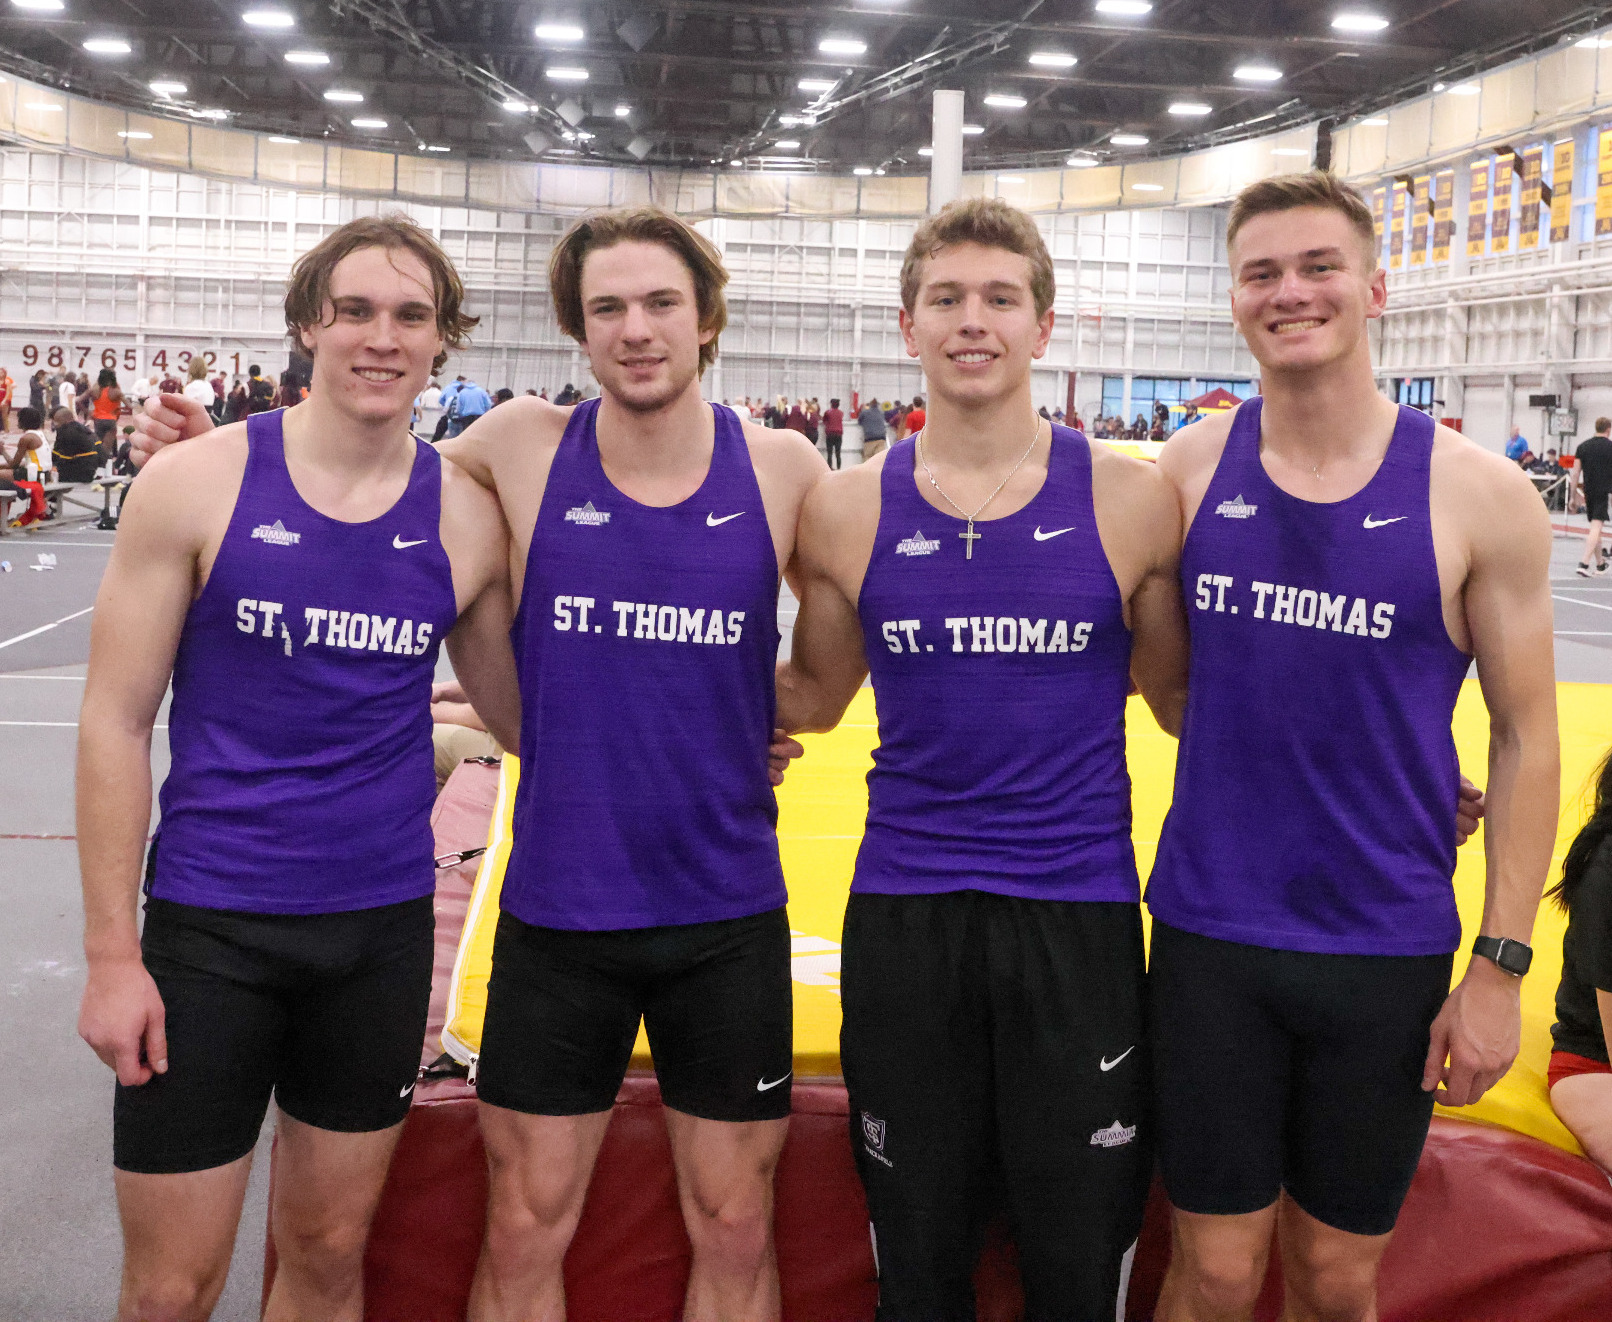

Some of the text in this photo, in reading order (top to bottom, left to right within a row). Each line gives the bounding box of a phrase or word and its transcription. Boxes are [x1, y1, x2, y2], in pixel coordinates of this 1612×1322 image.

[22, 344, 38, 366] 9
[47, 346, 63, 367] 8
[75, 346, 91, 368] 7
[101, 348, 117, 368] 6
[123, 349, 136, 371] 5
[152, 349, 168, 371] 4
[230, 352, 239, 374] 1
[564, 510, 611, 523] SUMMIT
[1215, 504, 1258, 515] SUMMIT
[251, 527, 301, 543] SUMMIT
[895, 540, 941, 554] SUMMIT
[553, 595, 746, 645] ST. THOMAS
[1196, 573, 1396, 639] ST. THOMAS
[304, 607, 433, 656] THOMAS
[881, 616, 1094, 654] ST. THOMAS
